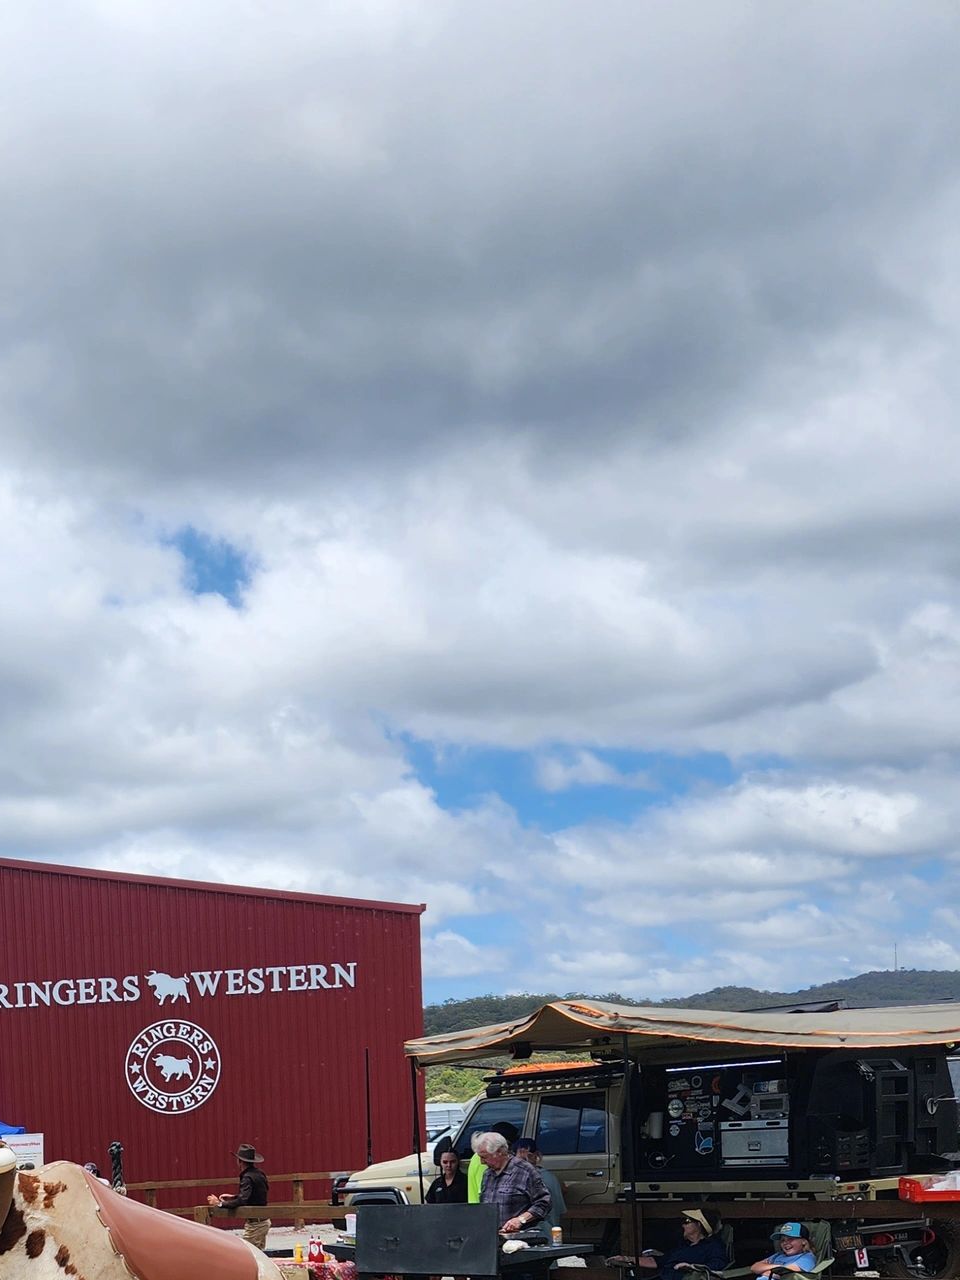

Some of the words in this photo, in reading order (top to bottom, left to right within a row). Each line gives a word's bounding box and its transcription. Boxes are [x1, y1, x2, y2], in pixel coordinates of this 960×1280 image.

[190, 962, 357, 997] WESTERN
[132, 1022, 213, 1058] RINGERS
[132, 1073, 215, 1111] WESTERN
